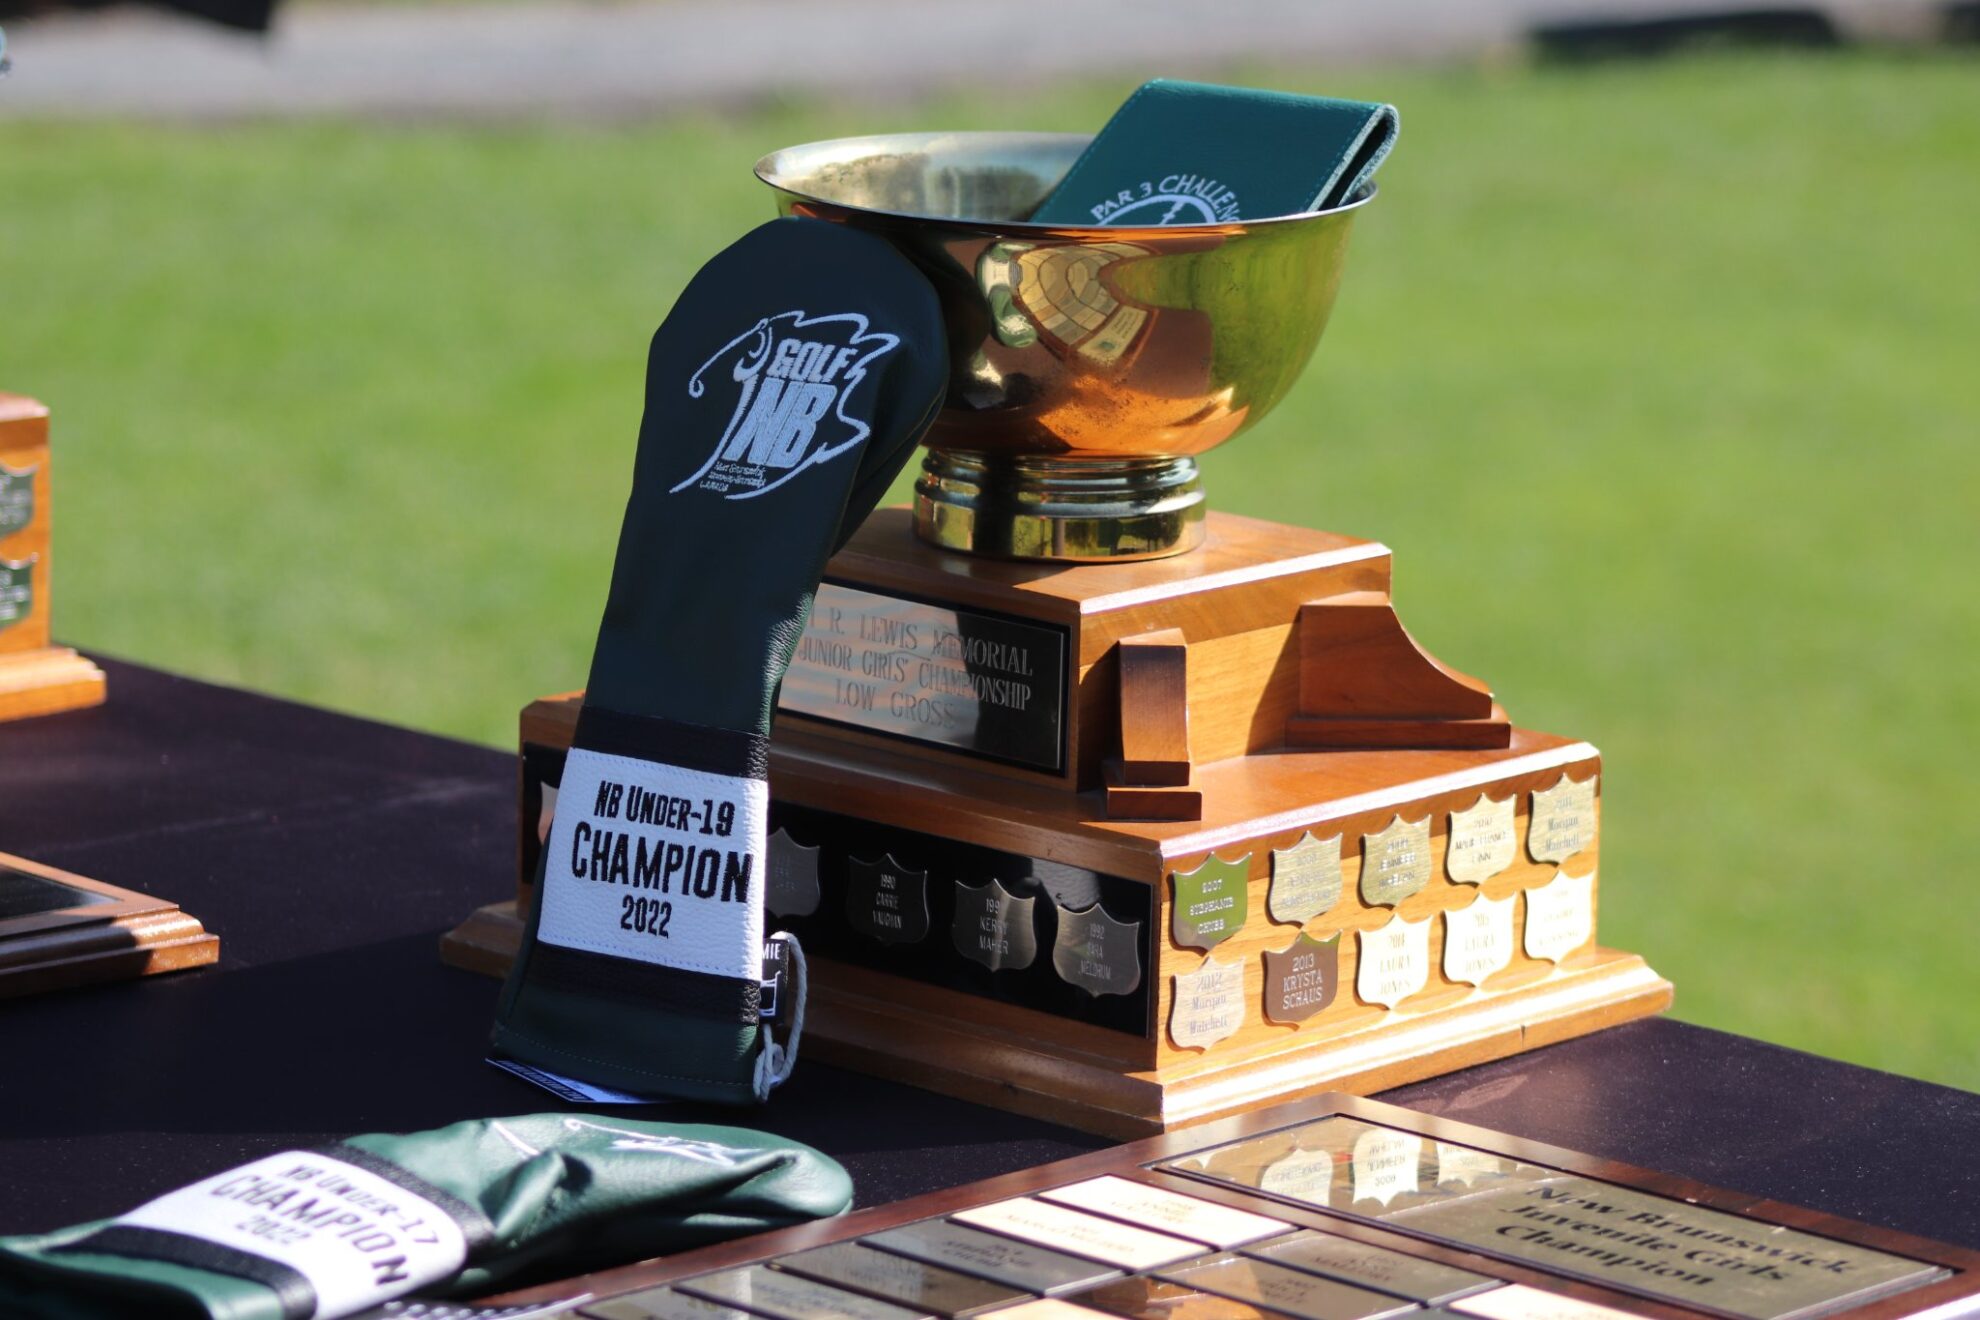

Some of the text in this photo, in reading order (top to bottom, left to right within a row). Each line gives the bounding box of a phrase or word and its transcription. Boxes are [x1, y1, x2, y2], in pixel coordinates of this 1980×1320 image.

[1090, 190, 1134, 220] PAR
[1139, 182, 1153, 198] 3
[766, 338, 859, 384] GOLF
[721, 376, 838, 469] NB
[859, 612, 918, 651] LEWIS
[930, 627, 1033, 677] MEMORIAL
[799, 636, 852, 671] JUNIOR
[919, 661, 1032, 711] CHAMPIONSHIP
[835, 678, 954, 730] LOW GROSS
[594, 780, 735, 837] NB UNDER-19
[571, 821, 754, 903] CHAMPION
[620, 894, 672, 939] 2022
[986, 898, 1001, 914] 199
[1283, 969, 1323, 993] KRYSTA
[1292, 953, 1314, 972] 2013
[1282, 986, 1323, 1010] SCHAUS
[211, 1174, 410, 1286] CHAMPION
[1495, 1225, 1715, 1286] Champion
[1497, 1205, 1789, 1280] Juvenile Girls
[1525, 1187, 1856, 1274] New Brunswick
